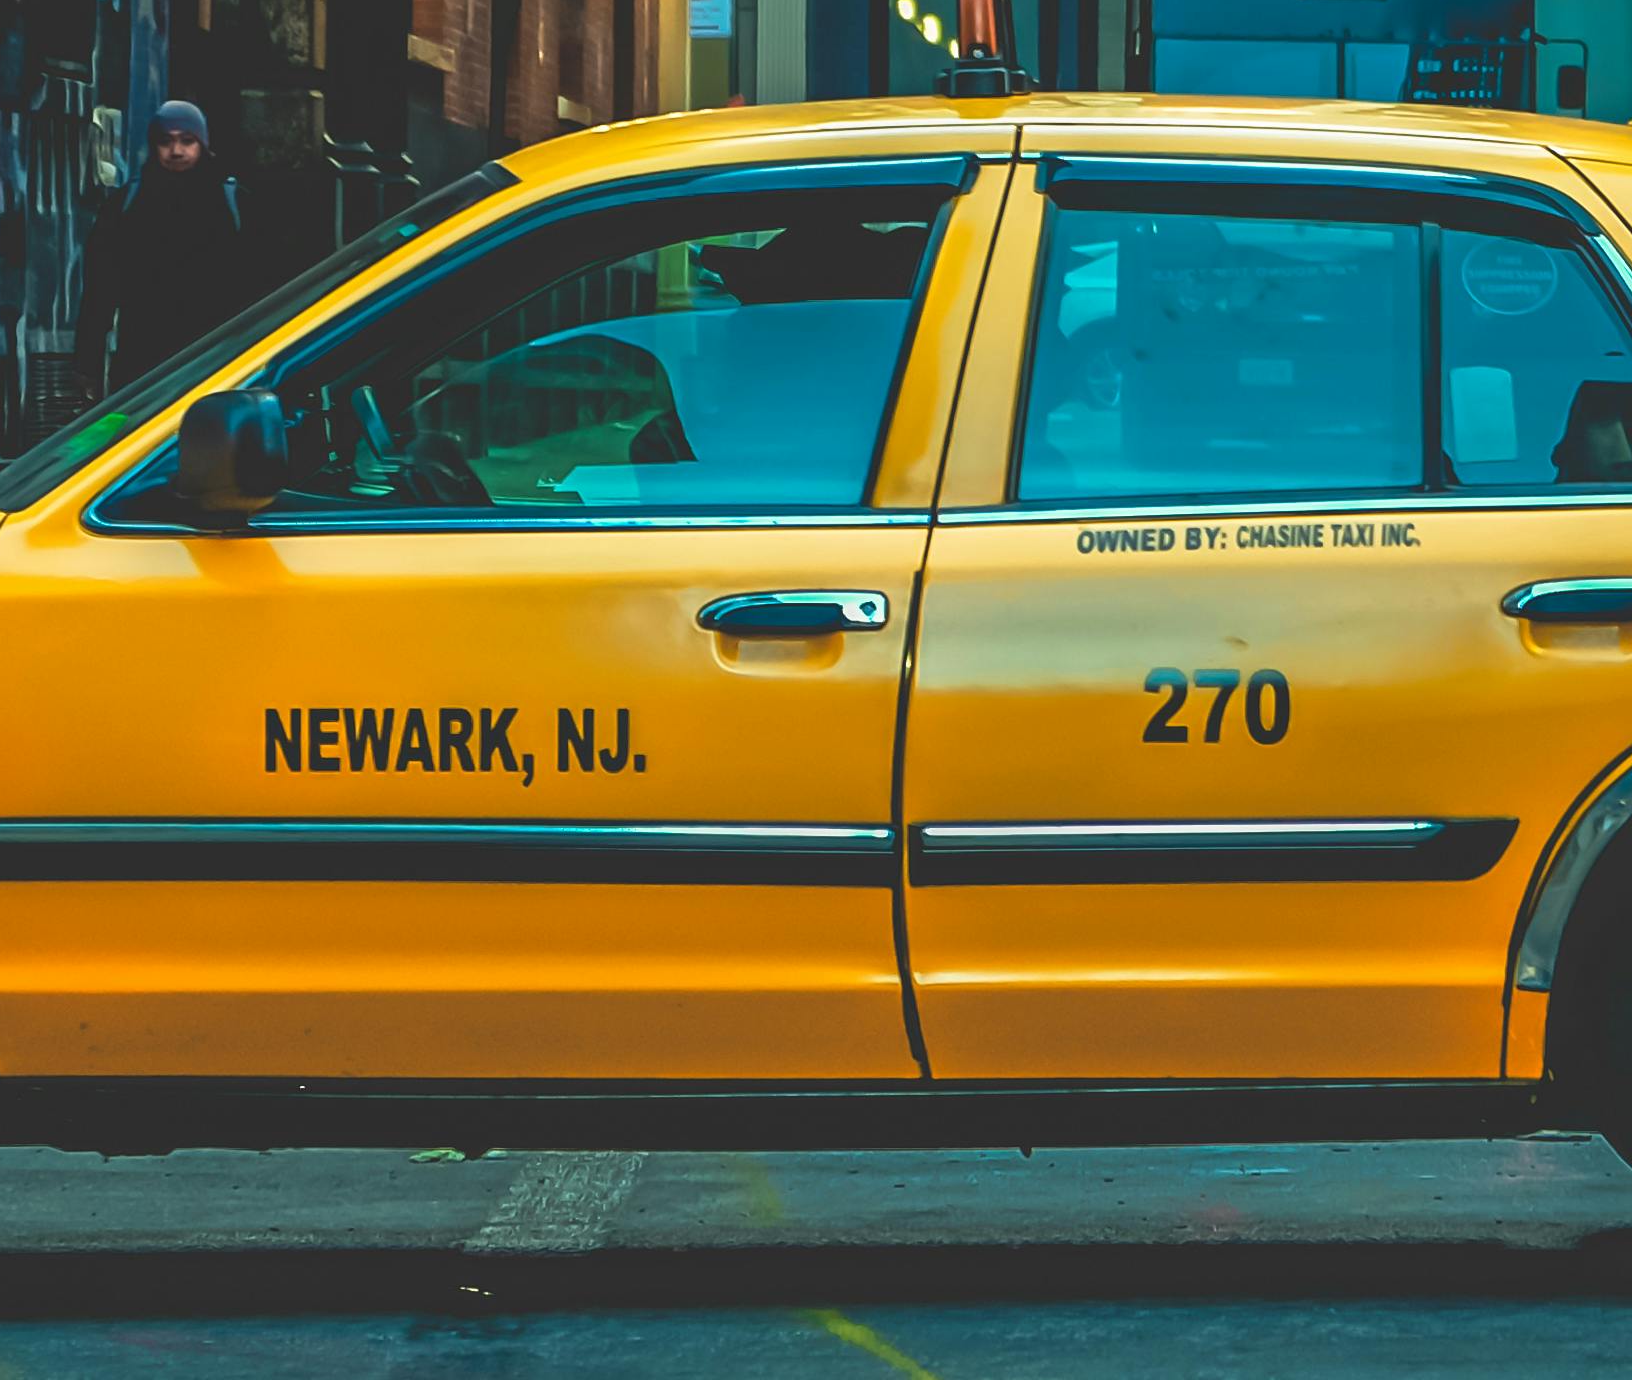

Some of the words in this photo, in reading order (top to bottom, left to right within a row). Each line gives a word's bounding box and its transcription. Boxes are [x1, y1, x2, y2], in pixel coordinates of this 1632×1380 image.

[1076, 527, 1176, 555] OWNED
[1184, 526, 1227, 551] BY:
[1235, 523, 1324, 549] CHASINE
[1330, 523, 1374, 548] TAXI
[1381, 522, 1421, 548] INC.
[1142, 666, 1291, 745] 270
[265, 707, 534, 787] NEWARK,
[557, 707, 648, 774] NJ.
